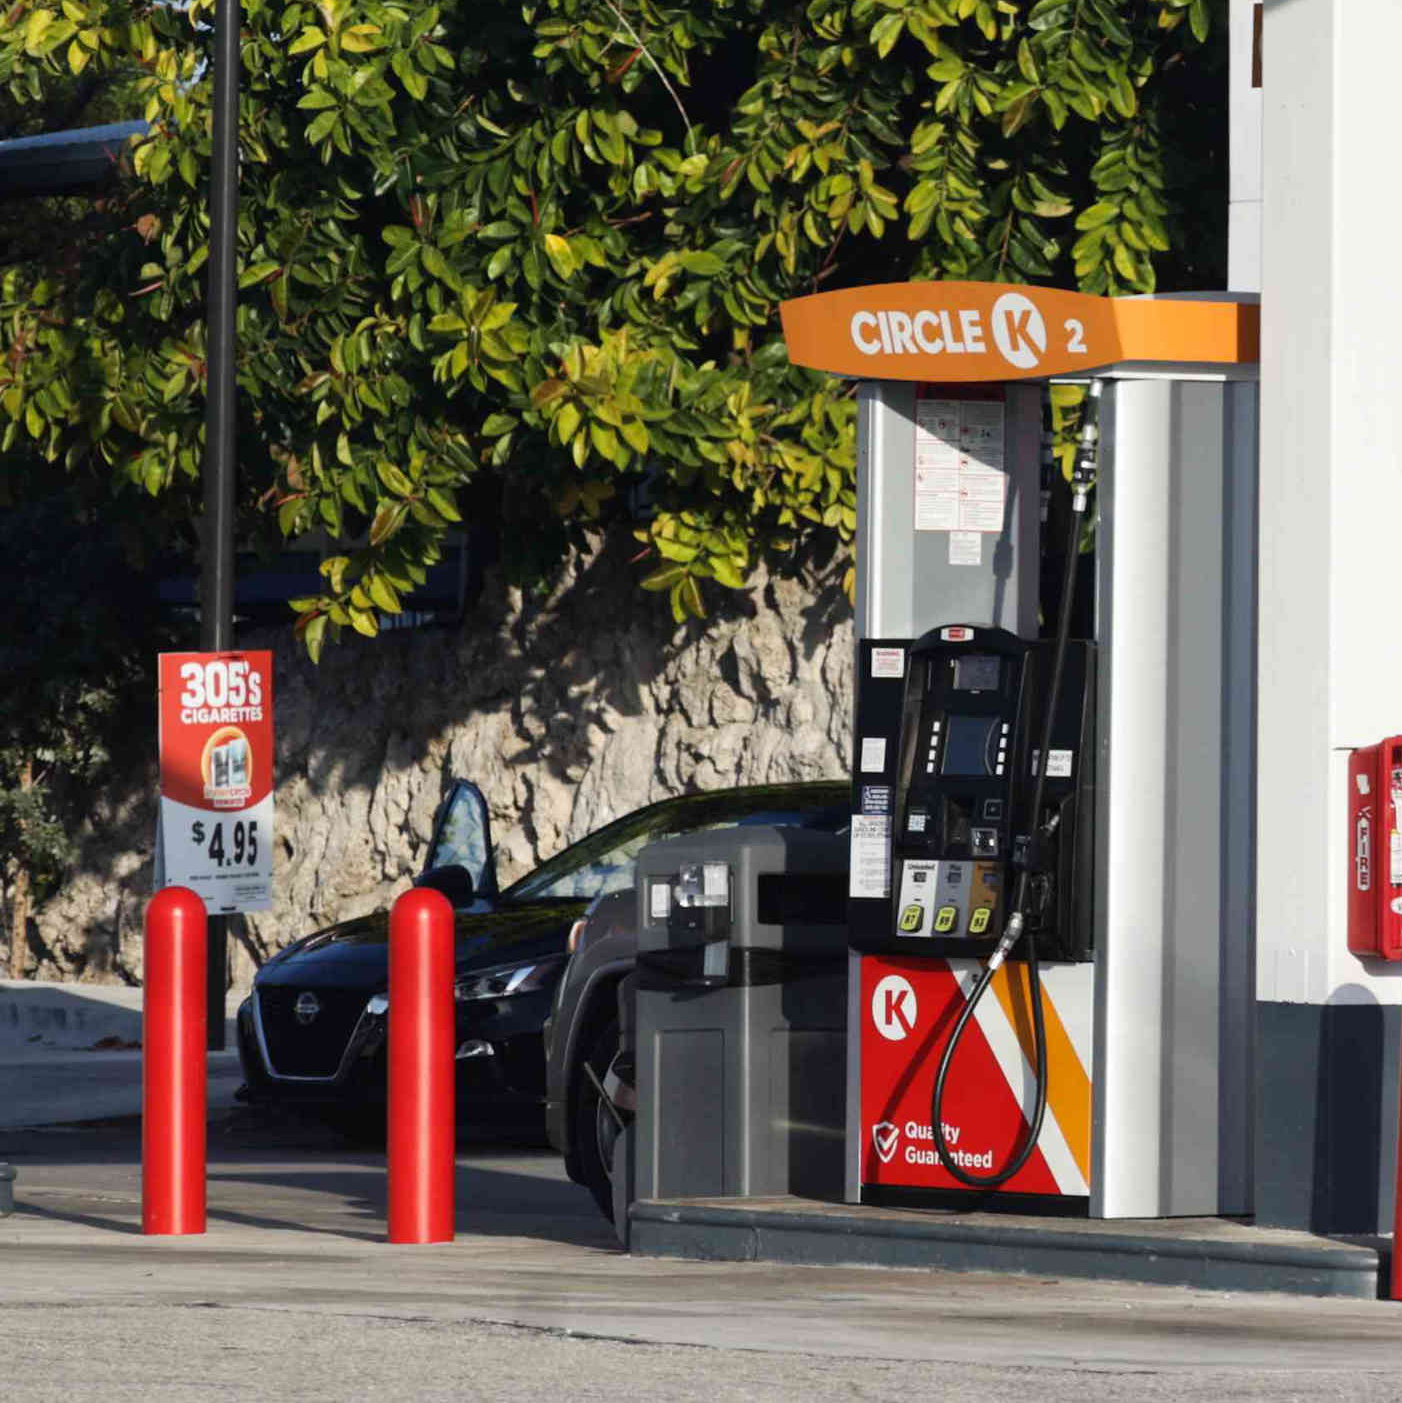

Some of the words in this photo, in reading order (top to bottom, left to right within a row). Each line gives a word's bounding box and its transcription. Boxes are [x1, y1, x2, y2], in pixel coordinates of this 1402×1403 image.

[850, 309, 986, 355] CIRCLE
[1064, 318, 1087, 353] 2
[180, 660, 262, 708] 305's
[180, 705, 263, 724] CIGARETTES
[1358, 826, 1370, 887] FIRE
[905, 1121, 960, 1144] Quaity
[905, 1146, 993, 1169] Guarnteed
